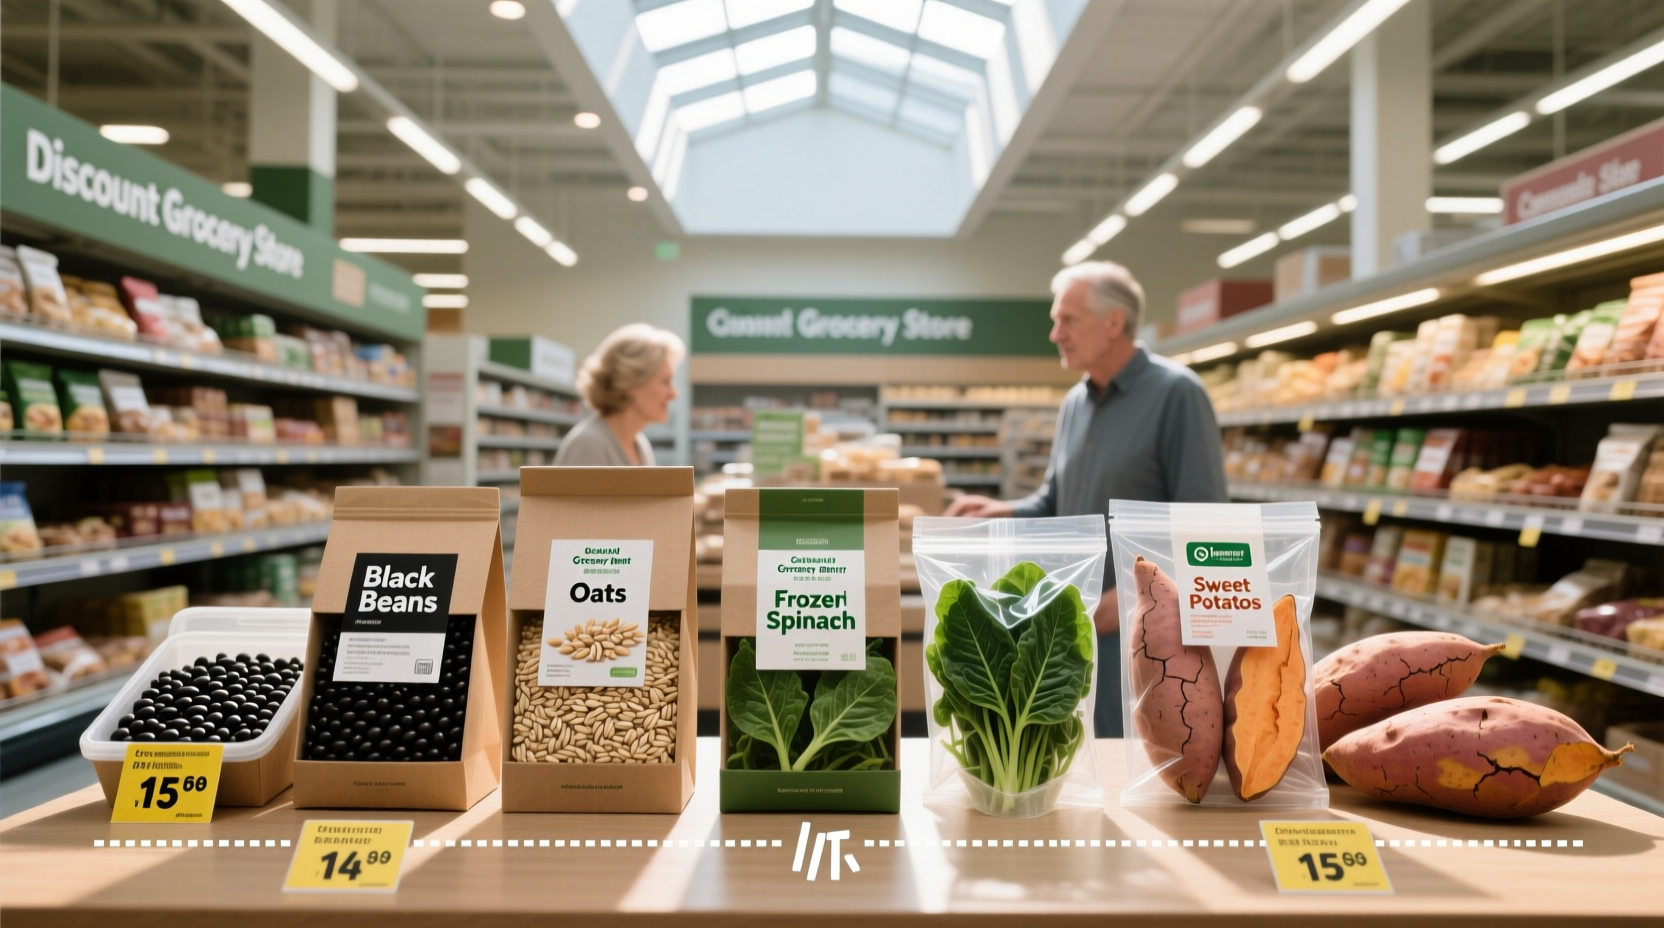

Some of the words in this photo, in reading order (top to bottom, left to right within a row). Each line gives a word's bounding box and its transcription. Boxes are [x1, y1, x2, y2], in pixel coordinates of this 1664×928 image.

[26, 127, 161, 227] Discount
[161, 187, 255, 271] Grocery
[253, 223, 305, 280] Store
[796, 306, 900, 347] Grocery
[902, 307, 974, 341] Store
[363, 564, 436, 589] Black
[1193, 576, 1252, 593] Sweet
[357, 589, 438, 613] Beans
[569, 582, 627, 603] Oats
[766, 610, 856, 636] Spinach
